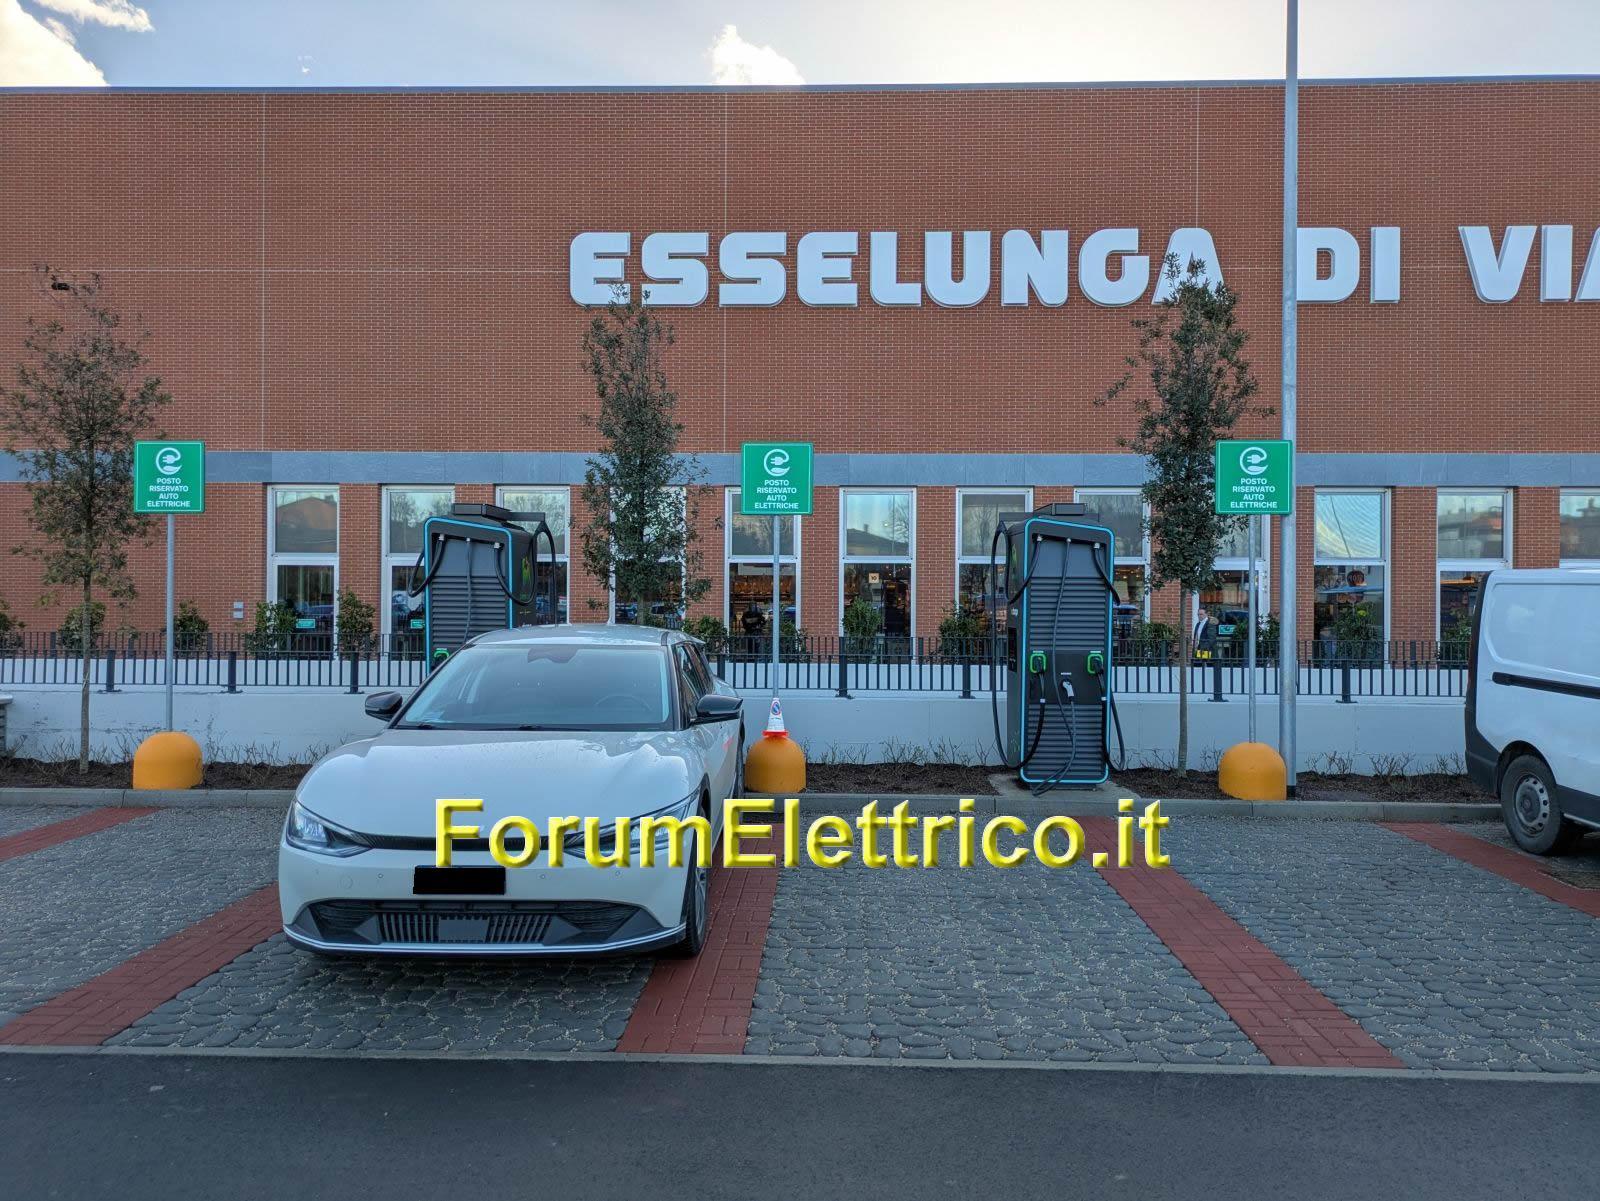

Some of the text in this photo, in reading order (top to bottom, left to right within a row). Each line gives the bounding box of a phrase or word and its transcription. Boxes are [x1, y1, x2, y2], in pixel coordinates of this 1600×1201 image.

[570, 228, 1224, 308] ESSELUNGA
[1297, 226, 1400, 304] DI
[156, 477, 181, 485] POSTO
[1240, 477, 1267, 485] POSTO
[1232, 485, 1276, 493] RISERVATO
[1230, 501, 1278, 509] ELETTRICHE
